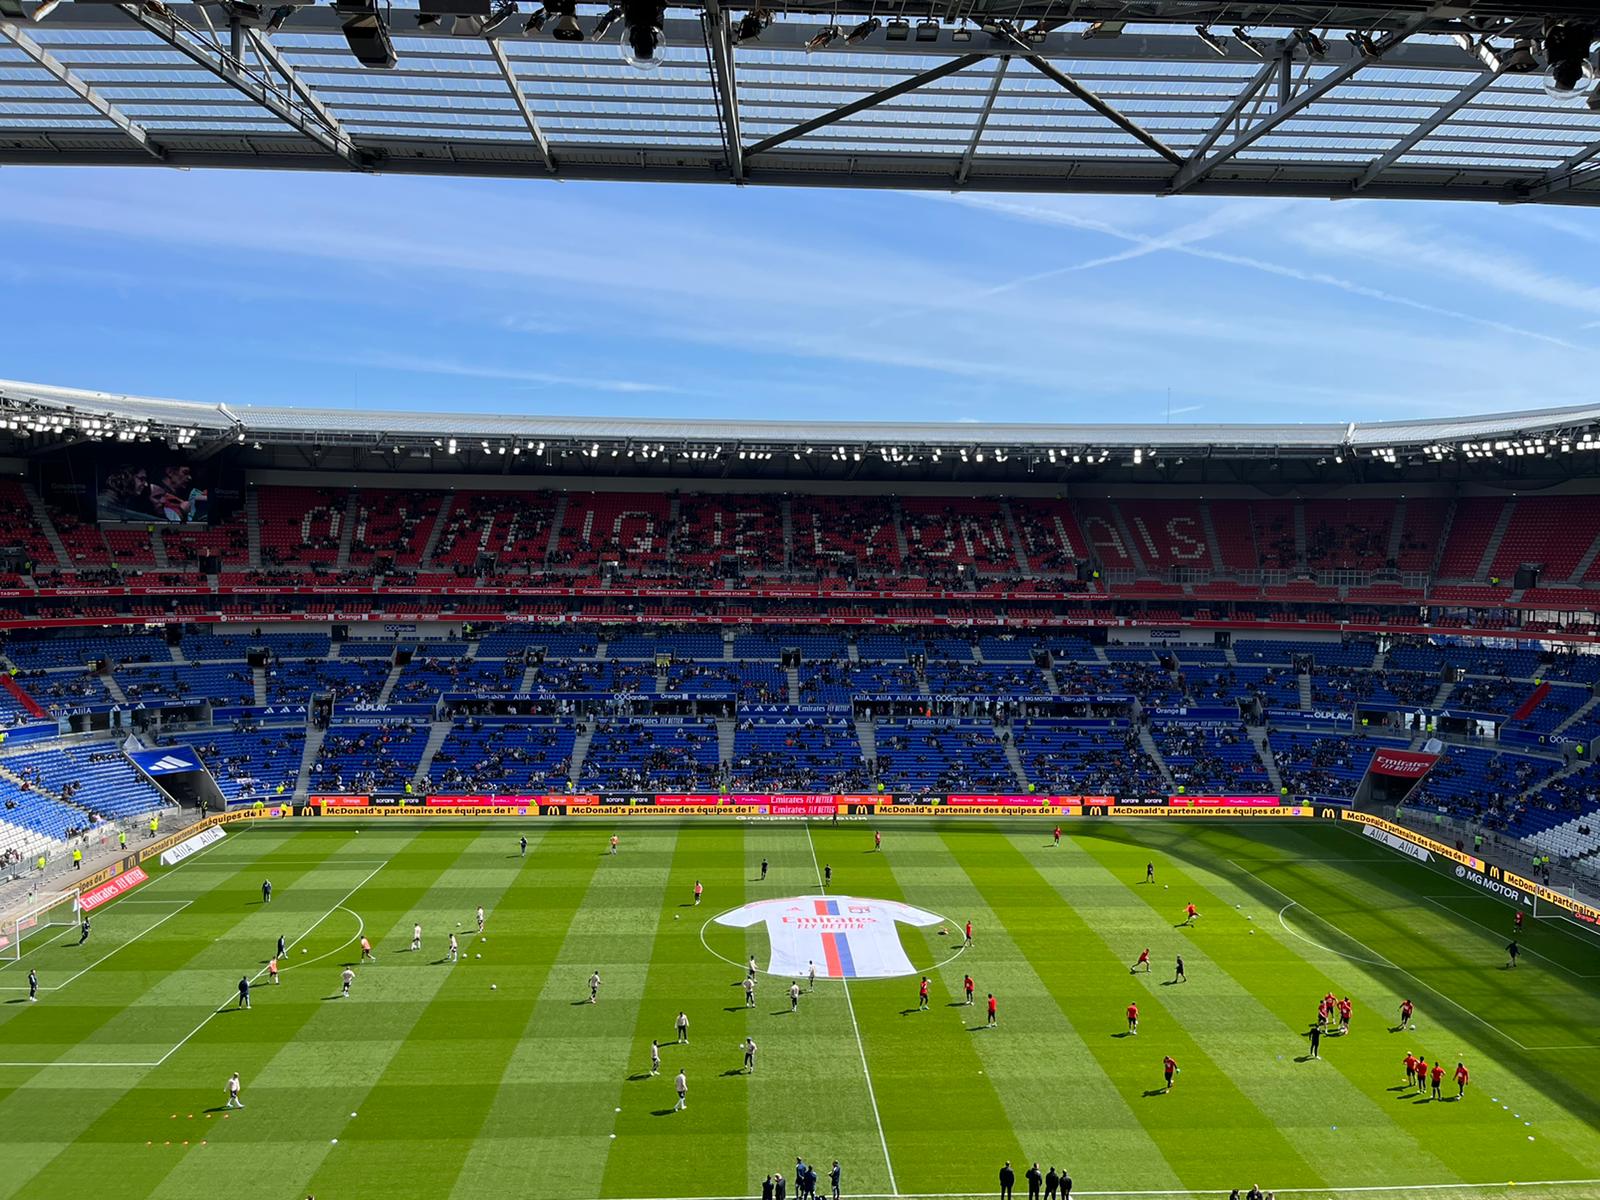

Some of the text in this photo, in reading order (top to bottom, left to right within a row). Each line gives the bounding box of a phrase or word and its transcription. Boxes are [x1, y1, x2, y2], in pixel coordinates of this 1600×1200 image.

[1376, 756, 1430, 768] Emirates
[770, 796, 804, 804] Emirates
[326, 807, 382, 815] McDonald's
[384, 807, 434, 816] partenaire
[435, 807, 453, 815] des
[454, 807, 492, 816] équipes
[493, 807, 506, 815] de
[572, 806, 626, 814] McDonald's
[628, 806, 677, 816] partenaire
[678, 806, 695, 814] des
[697, 806, 733, 816] équipes
[735, 806, 747, 814] de
[773, 806, 806, 814] Emirates
[879, 806, 932, 814] McDonald's
[934, 806, 982, 815] partenaire
[983, 806, 999, 814] des
[1001, 806, 1037, 815] équipes
[1038, 806, 1050, 814] de
[1167, 808, 1214, 816] partenaire
[1233, 808, 1268, 816] équipes
[1347, 812, 1388, 830] McDonald's
[1466, 871, 1520, 901] MG MOTOR
[81, 884, 118, 908] Emirates
[782, 916, 878, 924] Emirates
